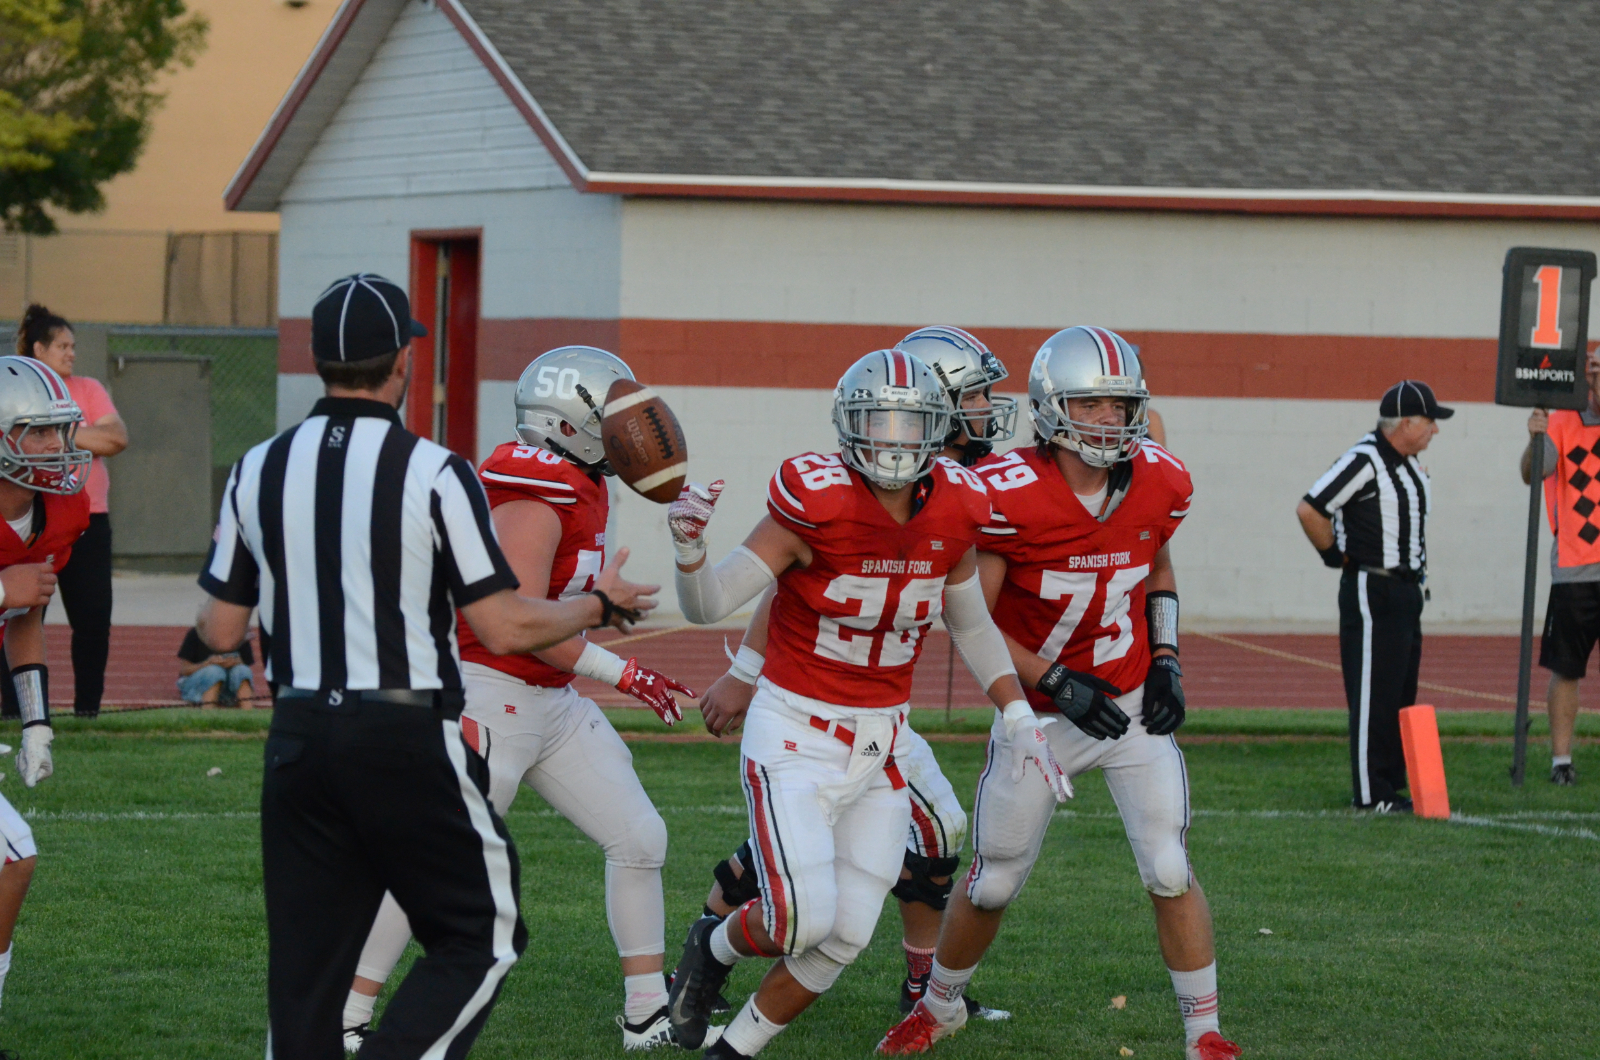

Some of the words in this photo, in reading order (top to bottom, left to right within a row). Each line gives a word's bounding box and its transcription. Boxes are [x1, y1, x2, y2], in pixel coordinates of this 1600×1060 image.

[1530, 265, 1563, 349] 1
[534, 366, 580, 400] 50
[1515, 368, 1538, 379] BSN
[1538, 369, 1576, 382] SPORTS
[626, 416, 650, 463] Wilson
[790, 454, 853, 491] 28
[977, 451, 1039, 491] 79
[861, 559, 906, 574] SPANISH
[907, 560, 934, 575] FORK
[1068, 553, 1109, 569] SPANISH
[1109, 551, 1131, 566] FORK
[813, 573, 948, 668] 28
